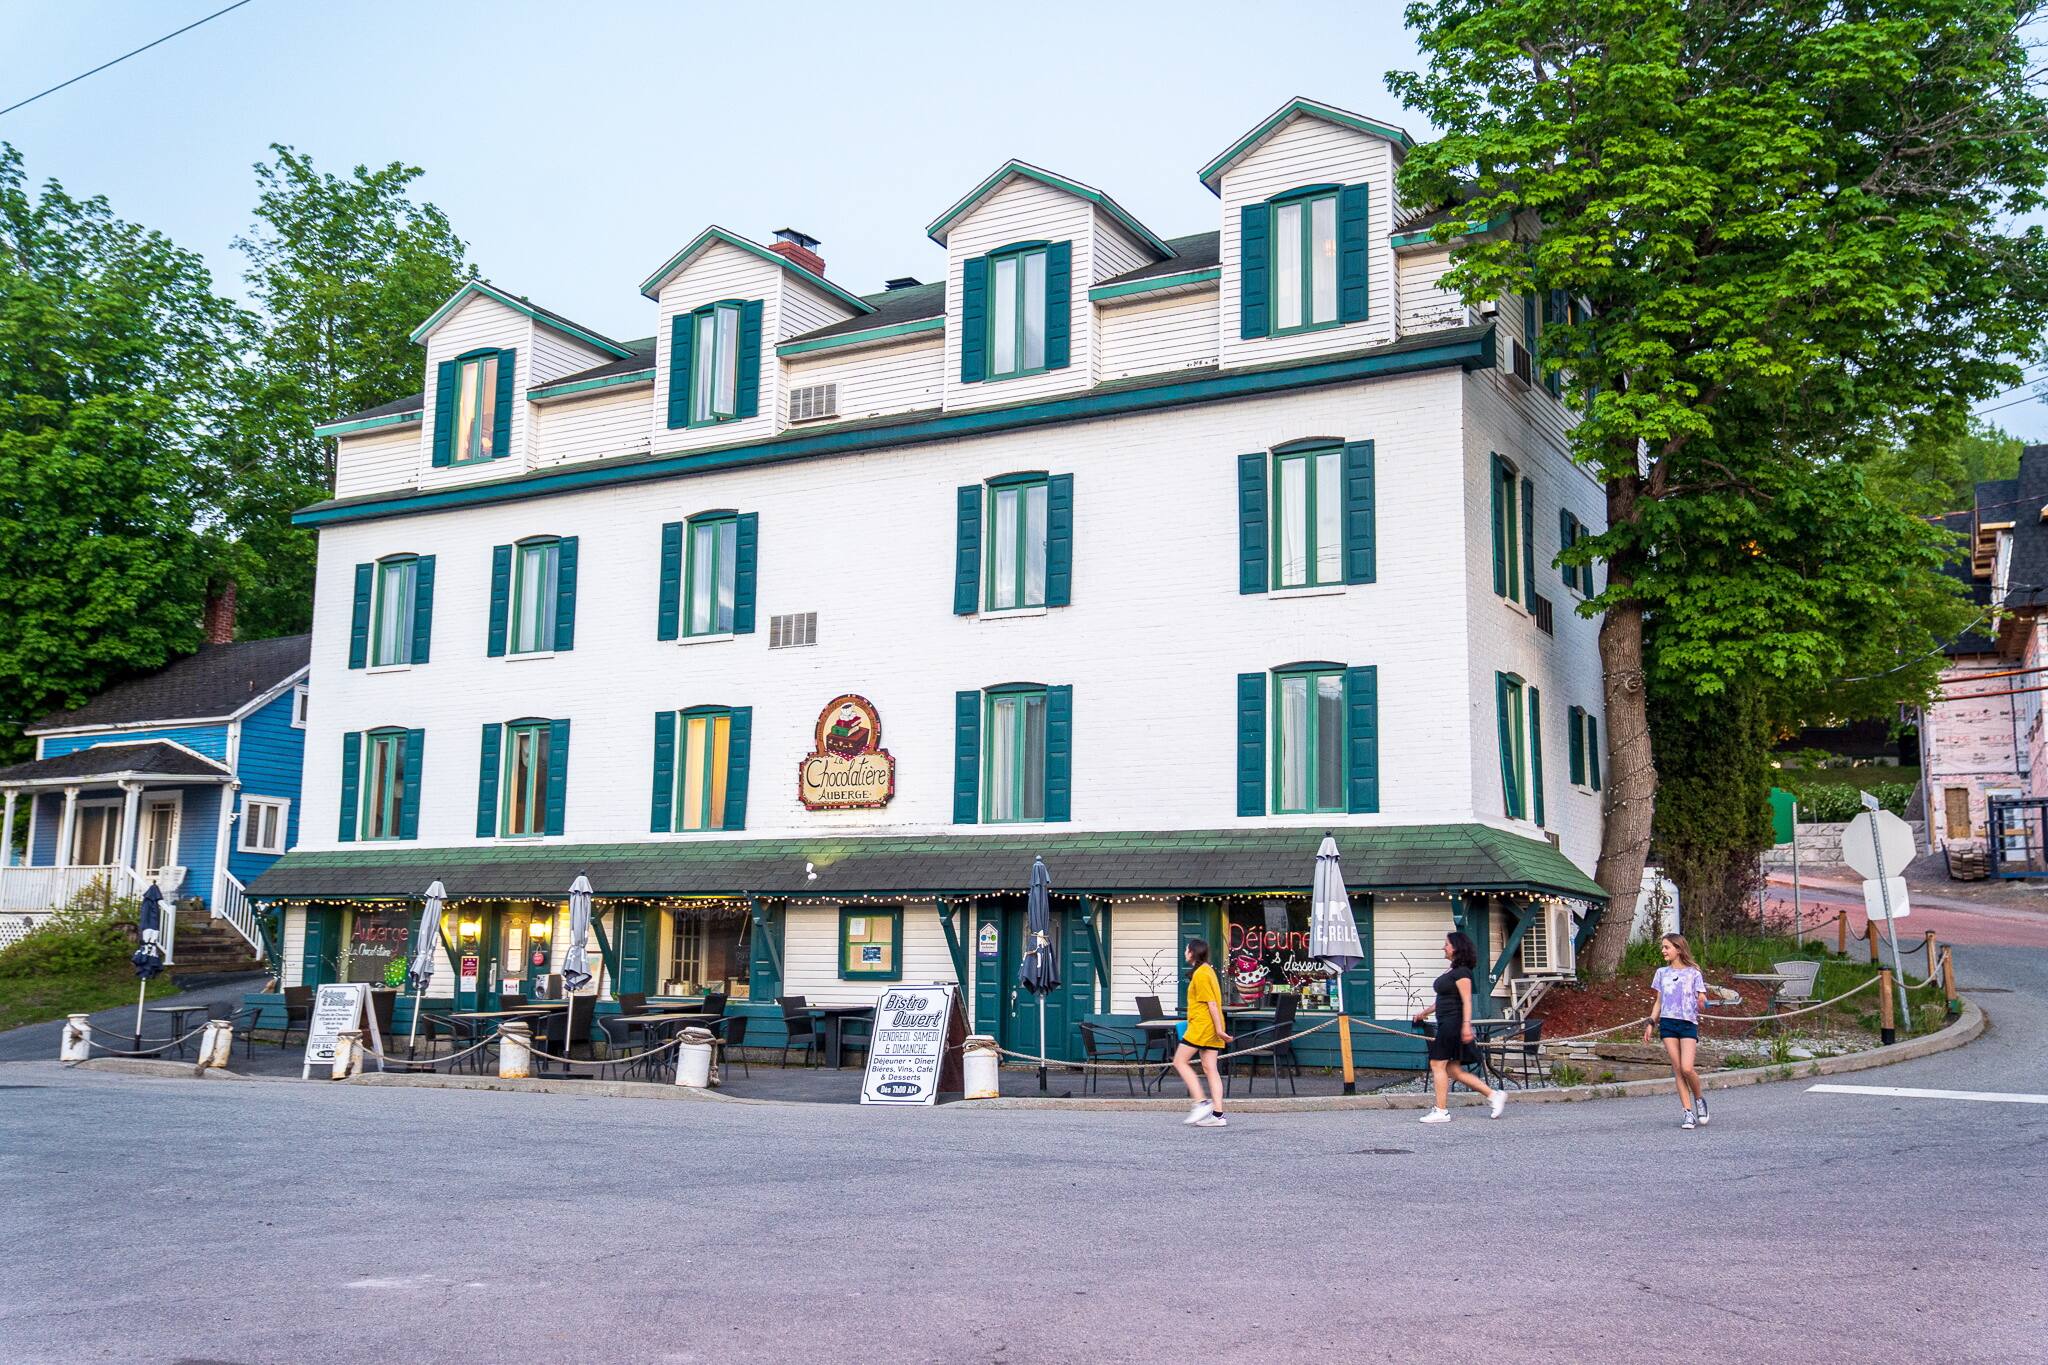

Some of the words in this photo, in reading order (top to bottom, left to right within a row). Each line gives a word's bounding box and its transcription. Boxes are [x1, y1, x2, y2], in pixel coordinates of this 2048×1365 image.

[806, 757, 886, 788] Chocolatière
[819, 789, 869, 800] AUBERGE
[1228, 923, 1311, 960] Déjeune
[884, 993, 929, 1011] Bistro
[892, 1010, 943, 1028] Ouvert
[913, 1032, 940, 1041] SAMEDI
[892, 1044, 928, 1053] DIMANCHE
[873, 1057, 906, 1066] Déjeuner
[888, 1073, 921, 1081] Desserts
[907, 1085, 918, 1094] AM
